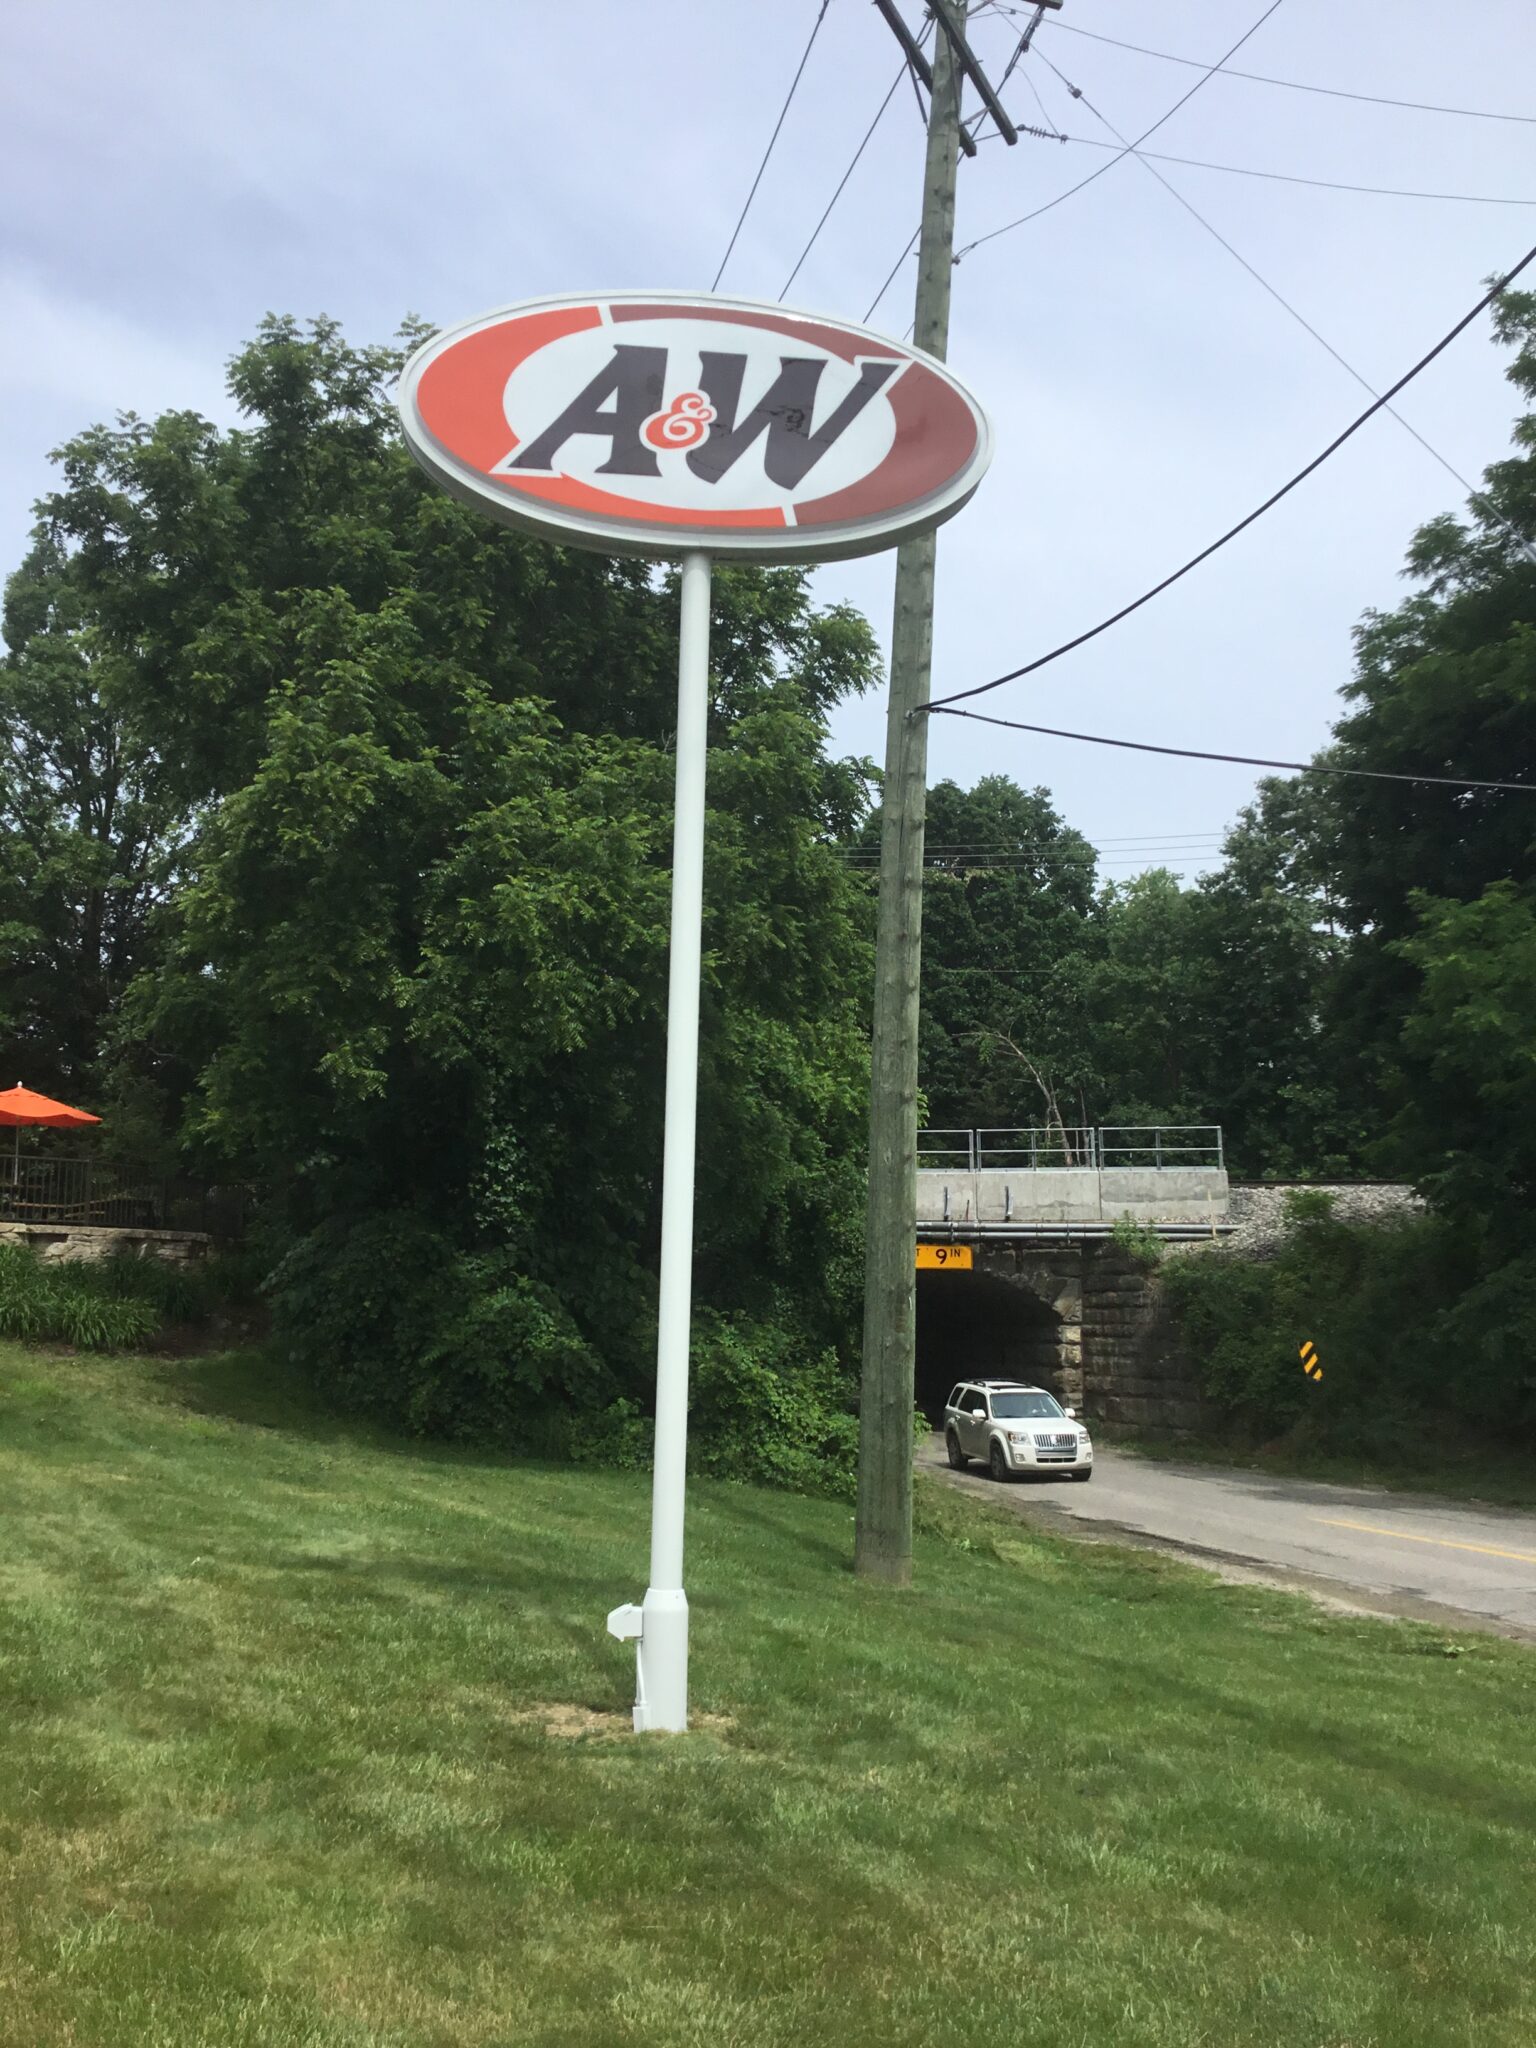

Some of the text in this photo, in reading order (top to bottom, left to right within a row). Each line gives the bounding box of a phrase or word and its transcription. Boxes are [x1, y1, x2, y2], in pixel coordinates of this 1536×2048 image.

[507, 344, 899, 490] A&W
[935, 1248, 947, 1264] 9
[950, 1248, 961, 1258] IN
